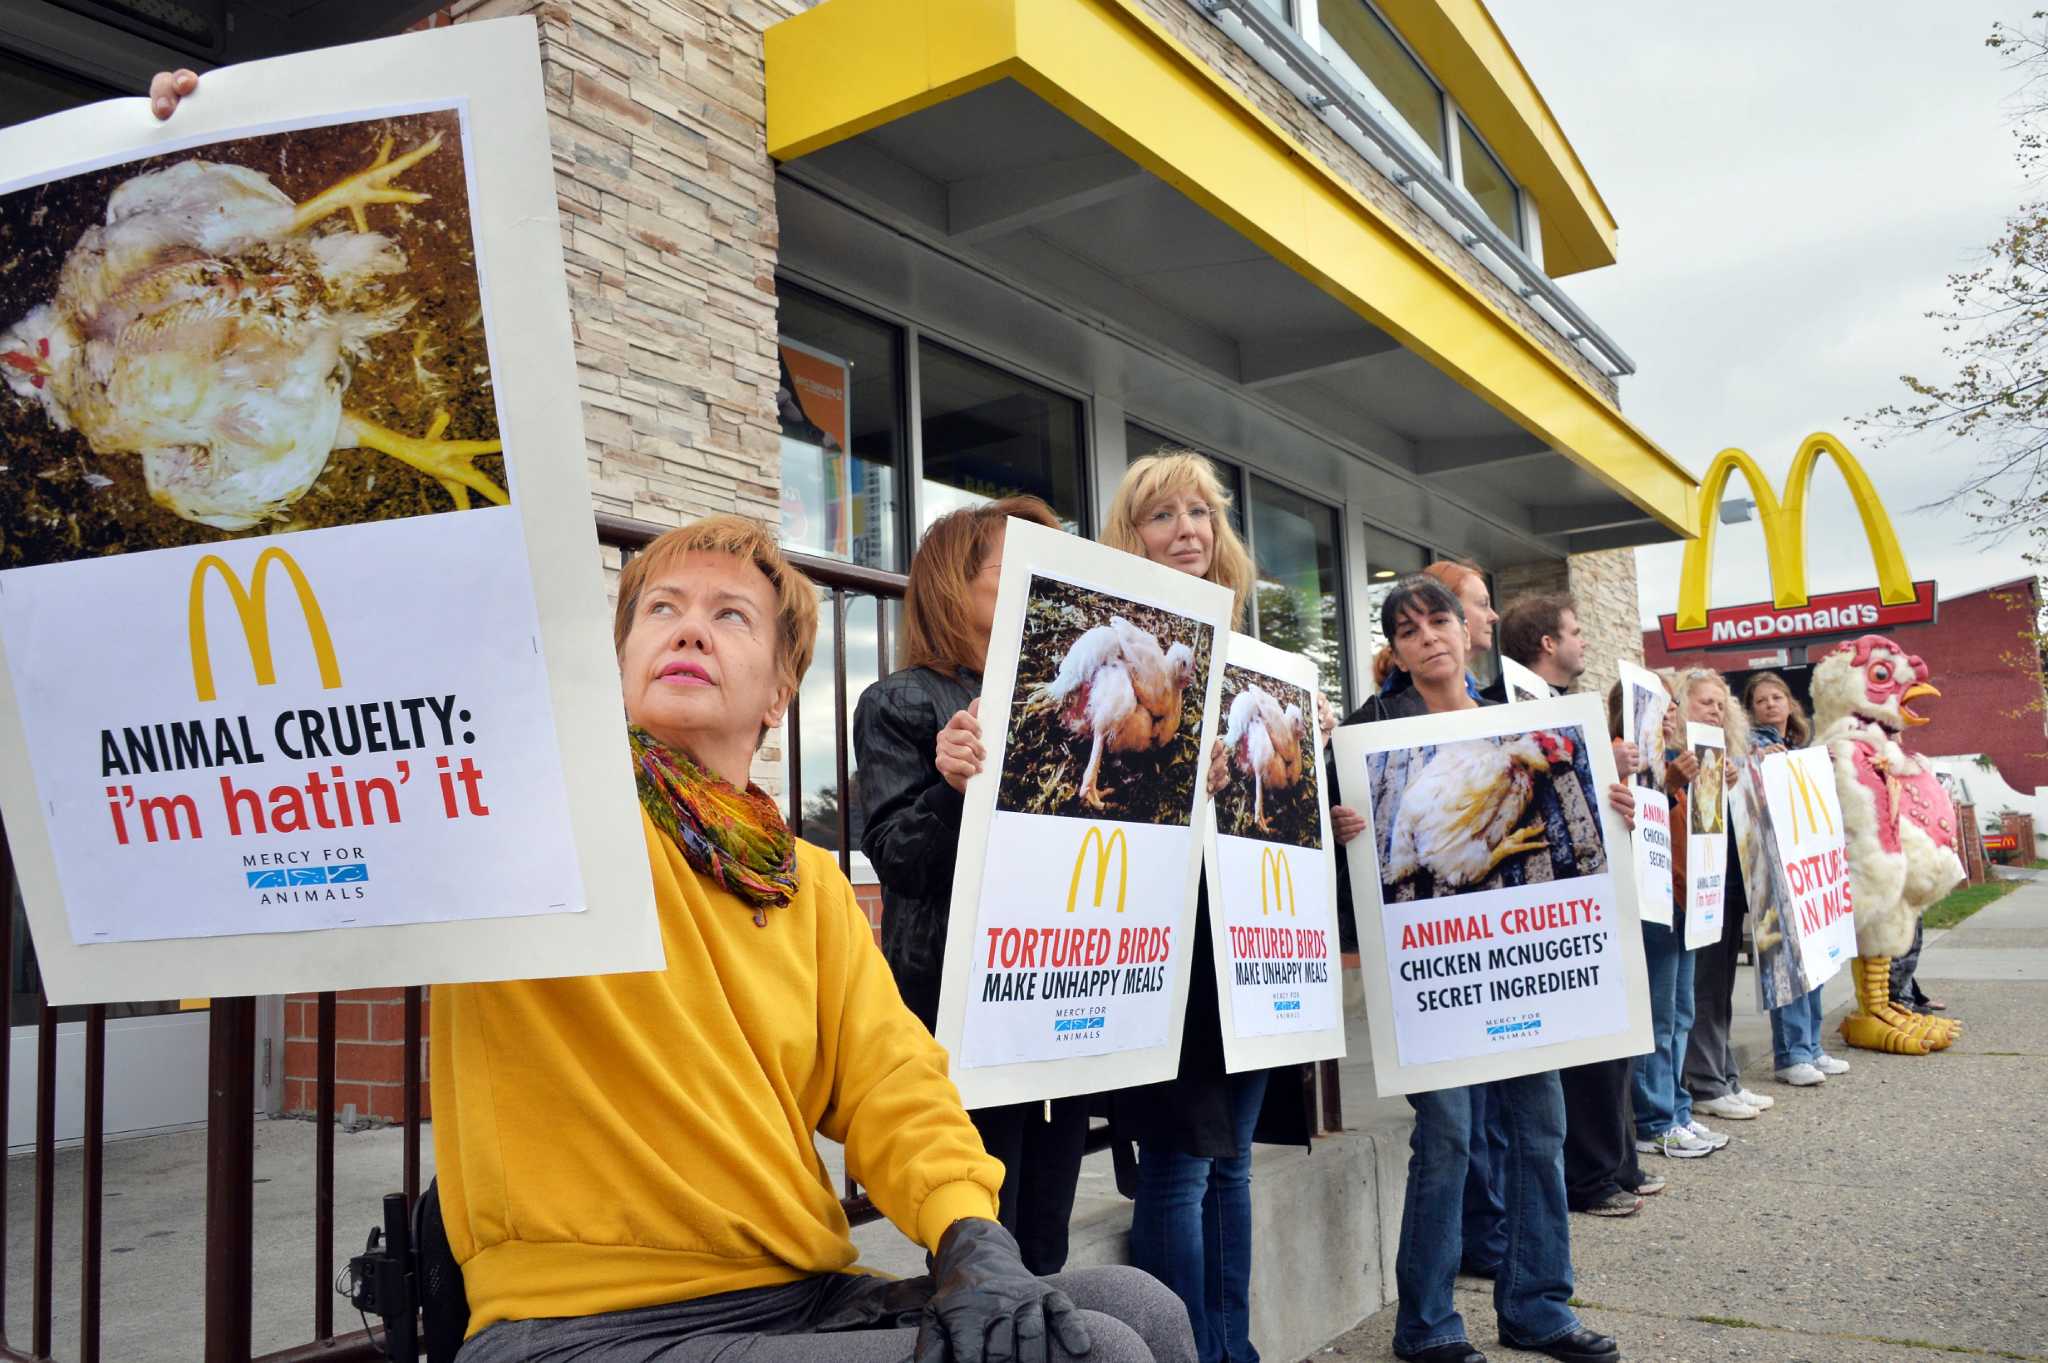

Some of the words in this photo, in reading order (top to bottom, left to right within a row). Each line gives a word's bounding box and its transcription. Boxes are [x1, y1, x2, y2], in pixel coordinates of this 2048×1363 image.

[1712, 603, 1878, 641] McDonald's
[101, 715, 264, 777] ANIMAL
[274, 695, 476, 759] CRUELTY:
[106, 785, 203, 845] i'm
[220, 760, 410, 836] hatin'
[437, 757, 489, 819] it
[243, 851, 310, 866] MERCY
[323, 847, 365, 861] FOR
[260, 887, 364, 905] ANIMALS
[1229, 926, 1294, 959] TORTURED
[1296, 929, 1327, 959] BIRDS
[1401, 914, 1494, 950] ANIMAL
[1500, 898, 1602, 935] CRUELTY:
[987, 927, 1111, 969] TORTURED
[1117, 926, 1171, 965] BIRDS
[1400, 952, 1482, 981] CHICKEN
[1488, 932, 1608, 970] MCNUGGETS'
[982, 972, 1037, 1002] MAKE
[1041, 969, 1121, 1000] UNHAPPY
[1122, 966, 1165, 995] MEALS
[1235, 962, 1261, 985] MAKE
[1262, 962, 1302, 985] UNHAPPY
[1304, 962, 1328, 983] MEALS
[1417, 983, 1483, 1012] SECRET
[1490, 966, 1600, 1002] INGREDIENT
[1056, 1008, 1085, 1017] MERCY
[1088, 1006, 1106, 1016] FOR
[1056, 1031, 1101, 1041] ANIMALS
